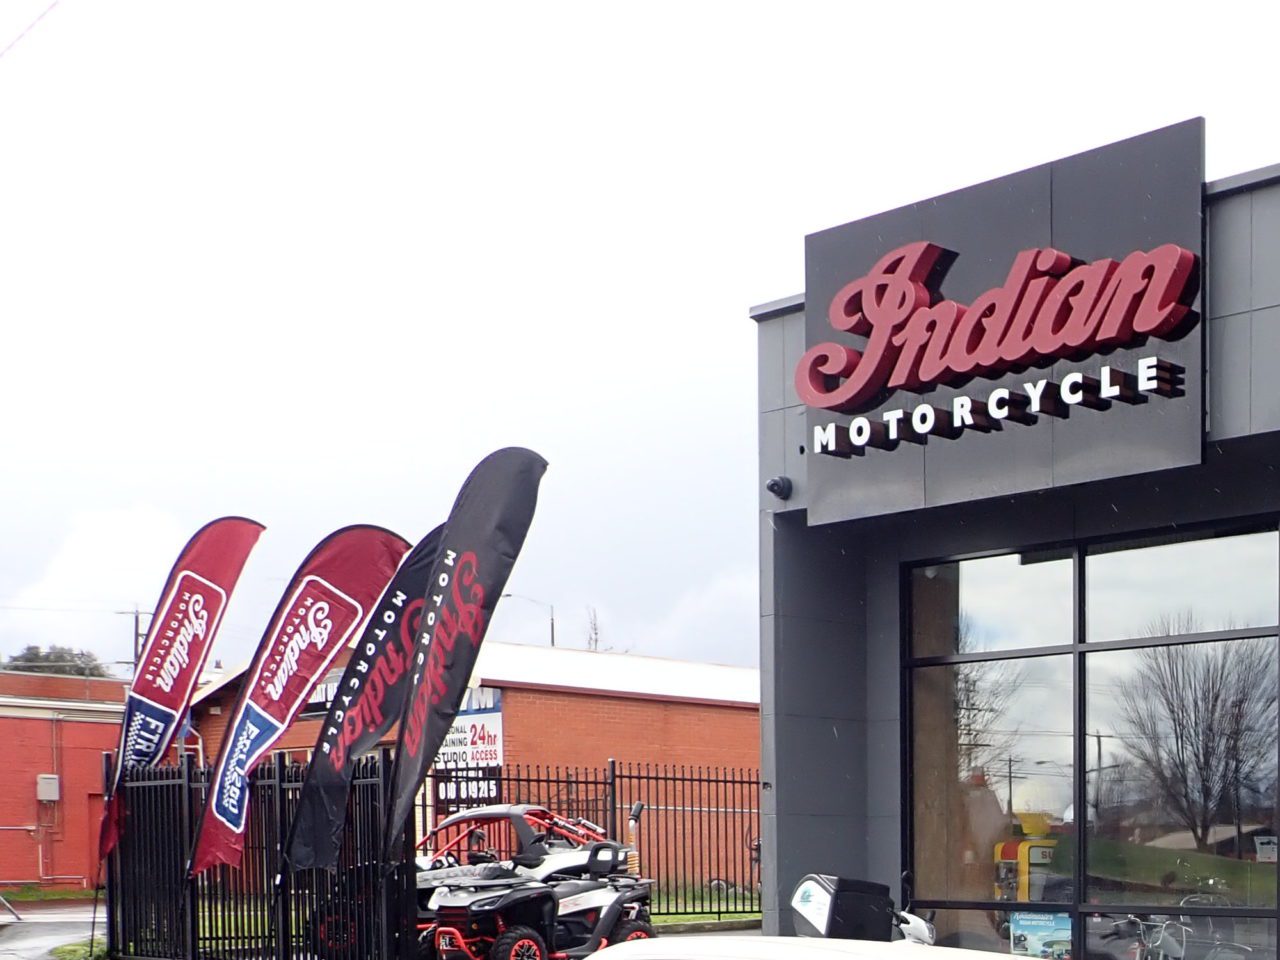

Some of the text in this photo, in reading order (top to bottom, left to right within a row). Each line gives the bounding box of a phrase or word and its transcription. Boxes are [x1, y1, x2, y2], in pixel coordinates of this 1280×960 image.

[795, 241, 1196, 410] Indian
[813, 356, 1158, 454] MOTORCYCLE
[145, 591, 191, 681] MOTORCYCLE
[157, 593, 208, 693] Indian
[264, 601, 332, 701] Indian
[322, 590, 408, 755] MOTORCYCLE
[471, 749, 498, 761] ACCESS
